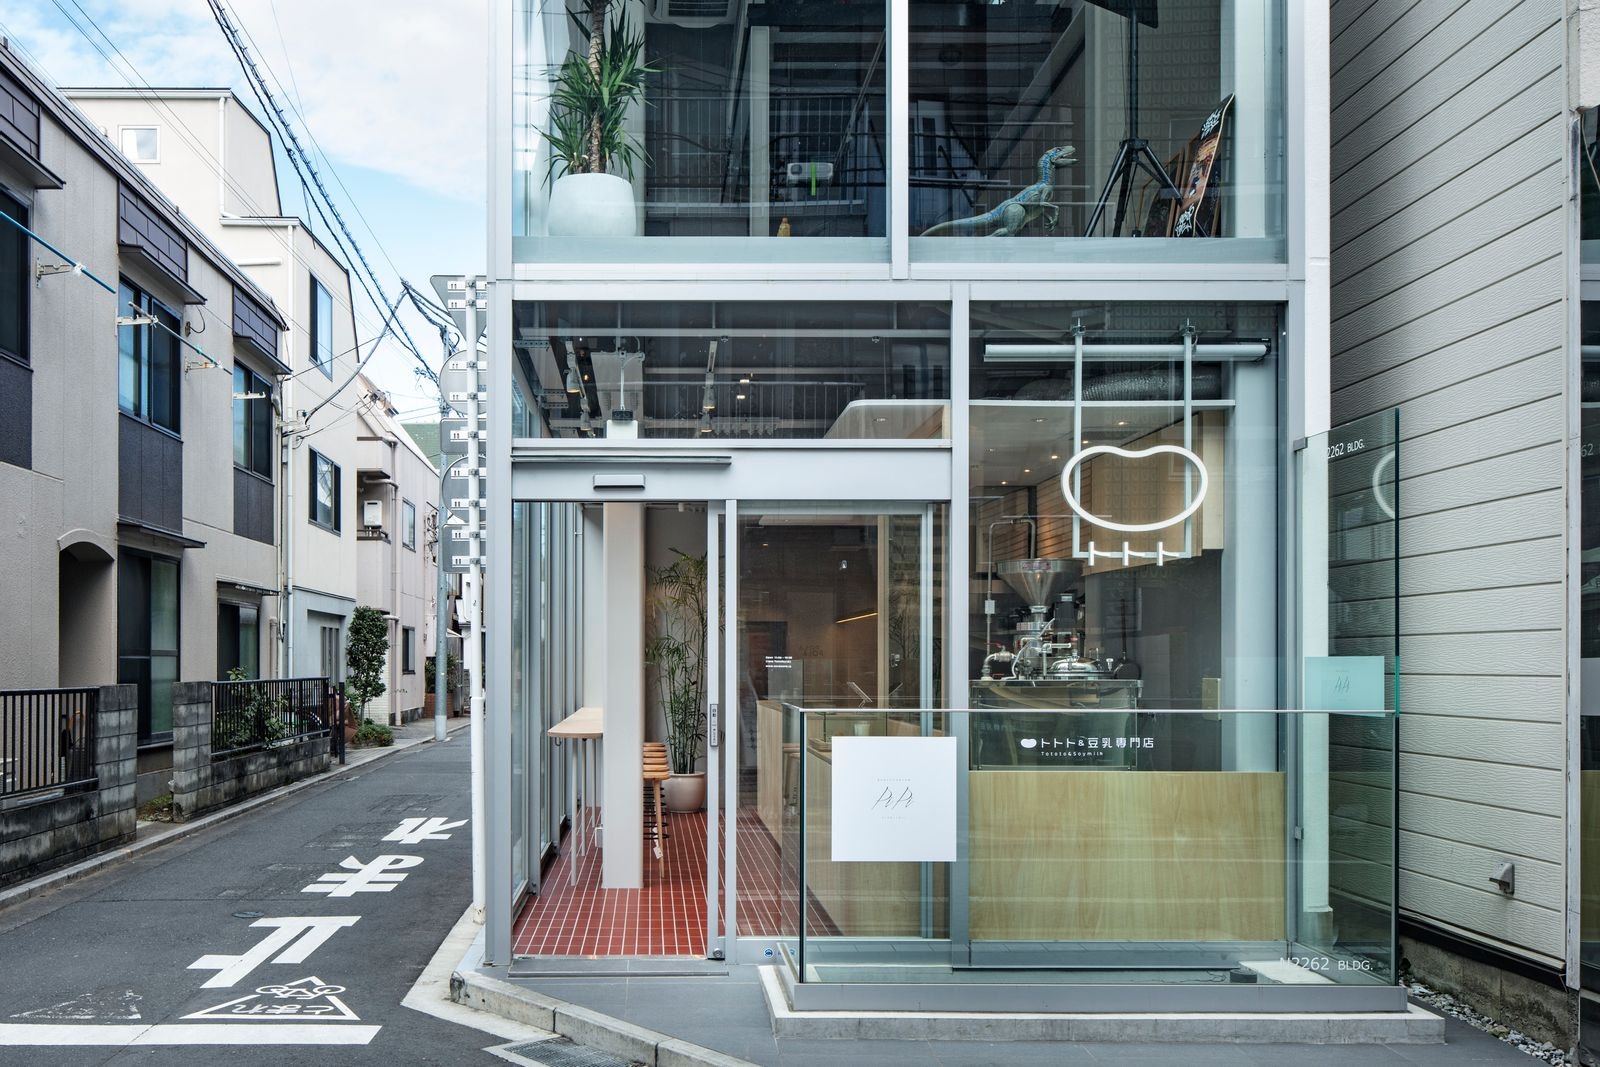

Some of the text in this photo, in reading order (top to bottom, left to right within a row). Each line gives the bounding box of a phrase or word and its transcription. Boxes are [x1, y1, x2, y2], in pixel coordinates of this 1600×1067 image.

[1347, 438, 1365, 453] BLDG.
[1041, 737, 1154, 749] トトト&豆乳専門店
[1338, 960, 1374, 971] BLDG.
[231, 1003, 335, 1015] とまれ
